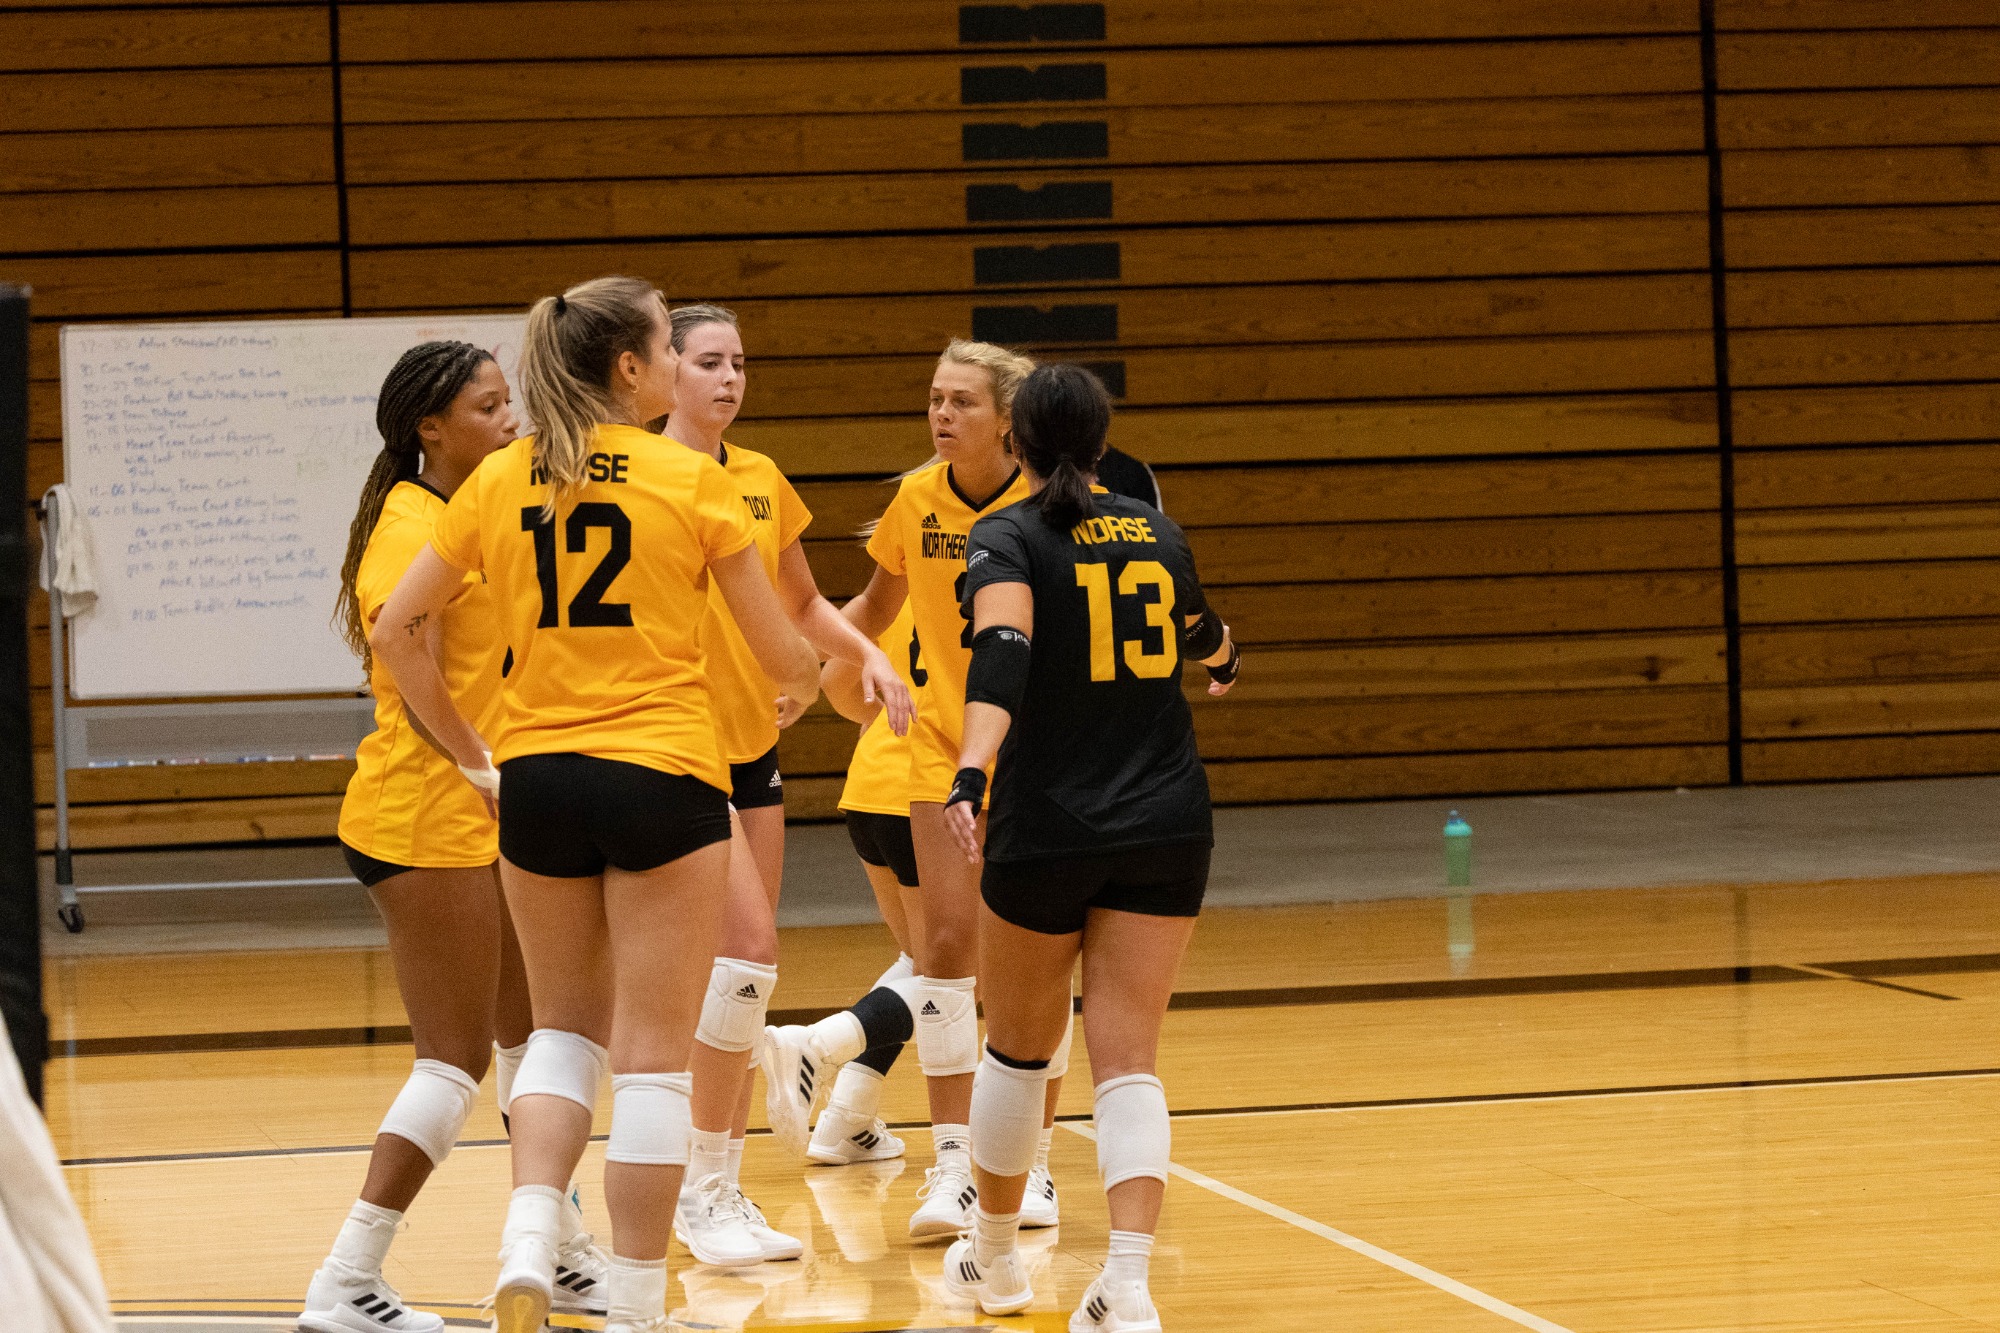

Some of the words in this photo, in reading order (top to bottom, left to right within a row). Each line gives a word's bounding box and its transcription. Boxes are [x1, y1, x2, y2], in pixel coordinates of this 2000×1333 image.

[521, 502, 634, 629] 12
[1071, 516, 1157, 545] NORSE
[1074, 561, 1178, 682] 13
